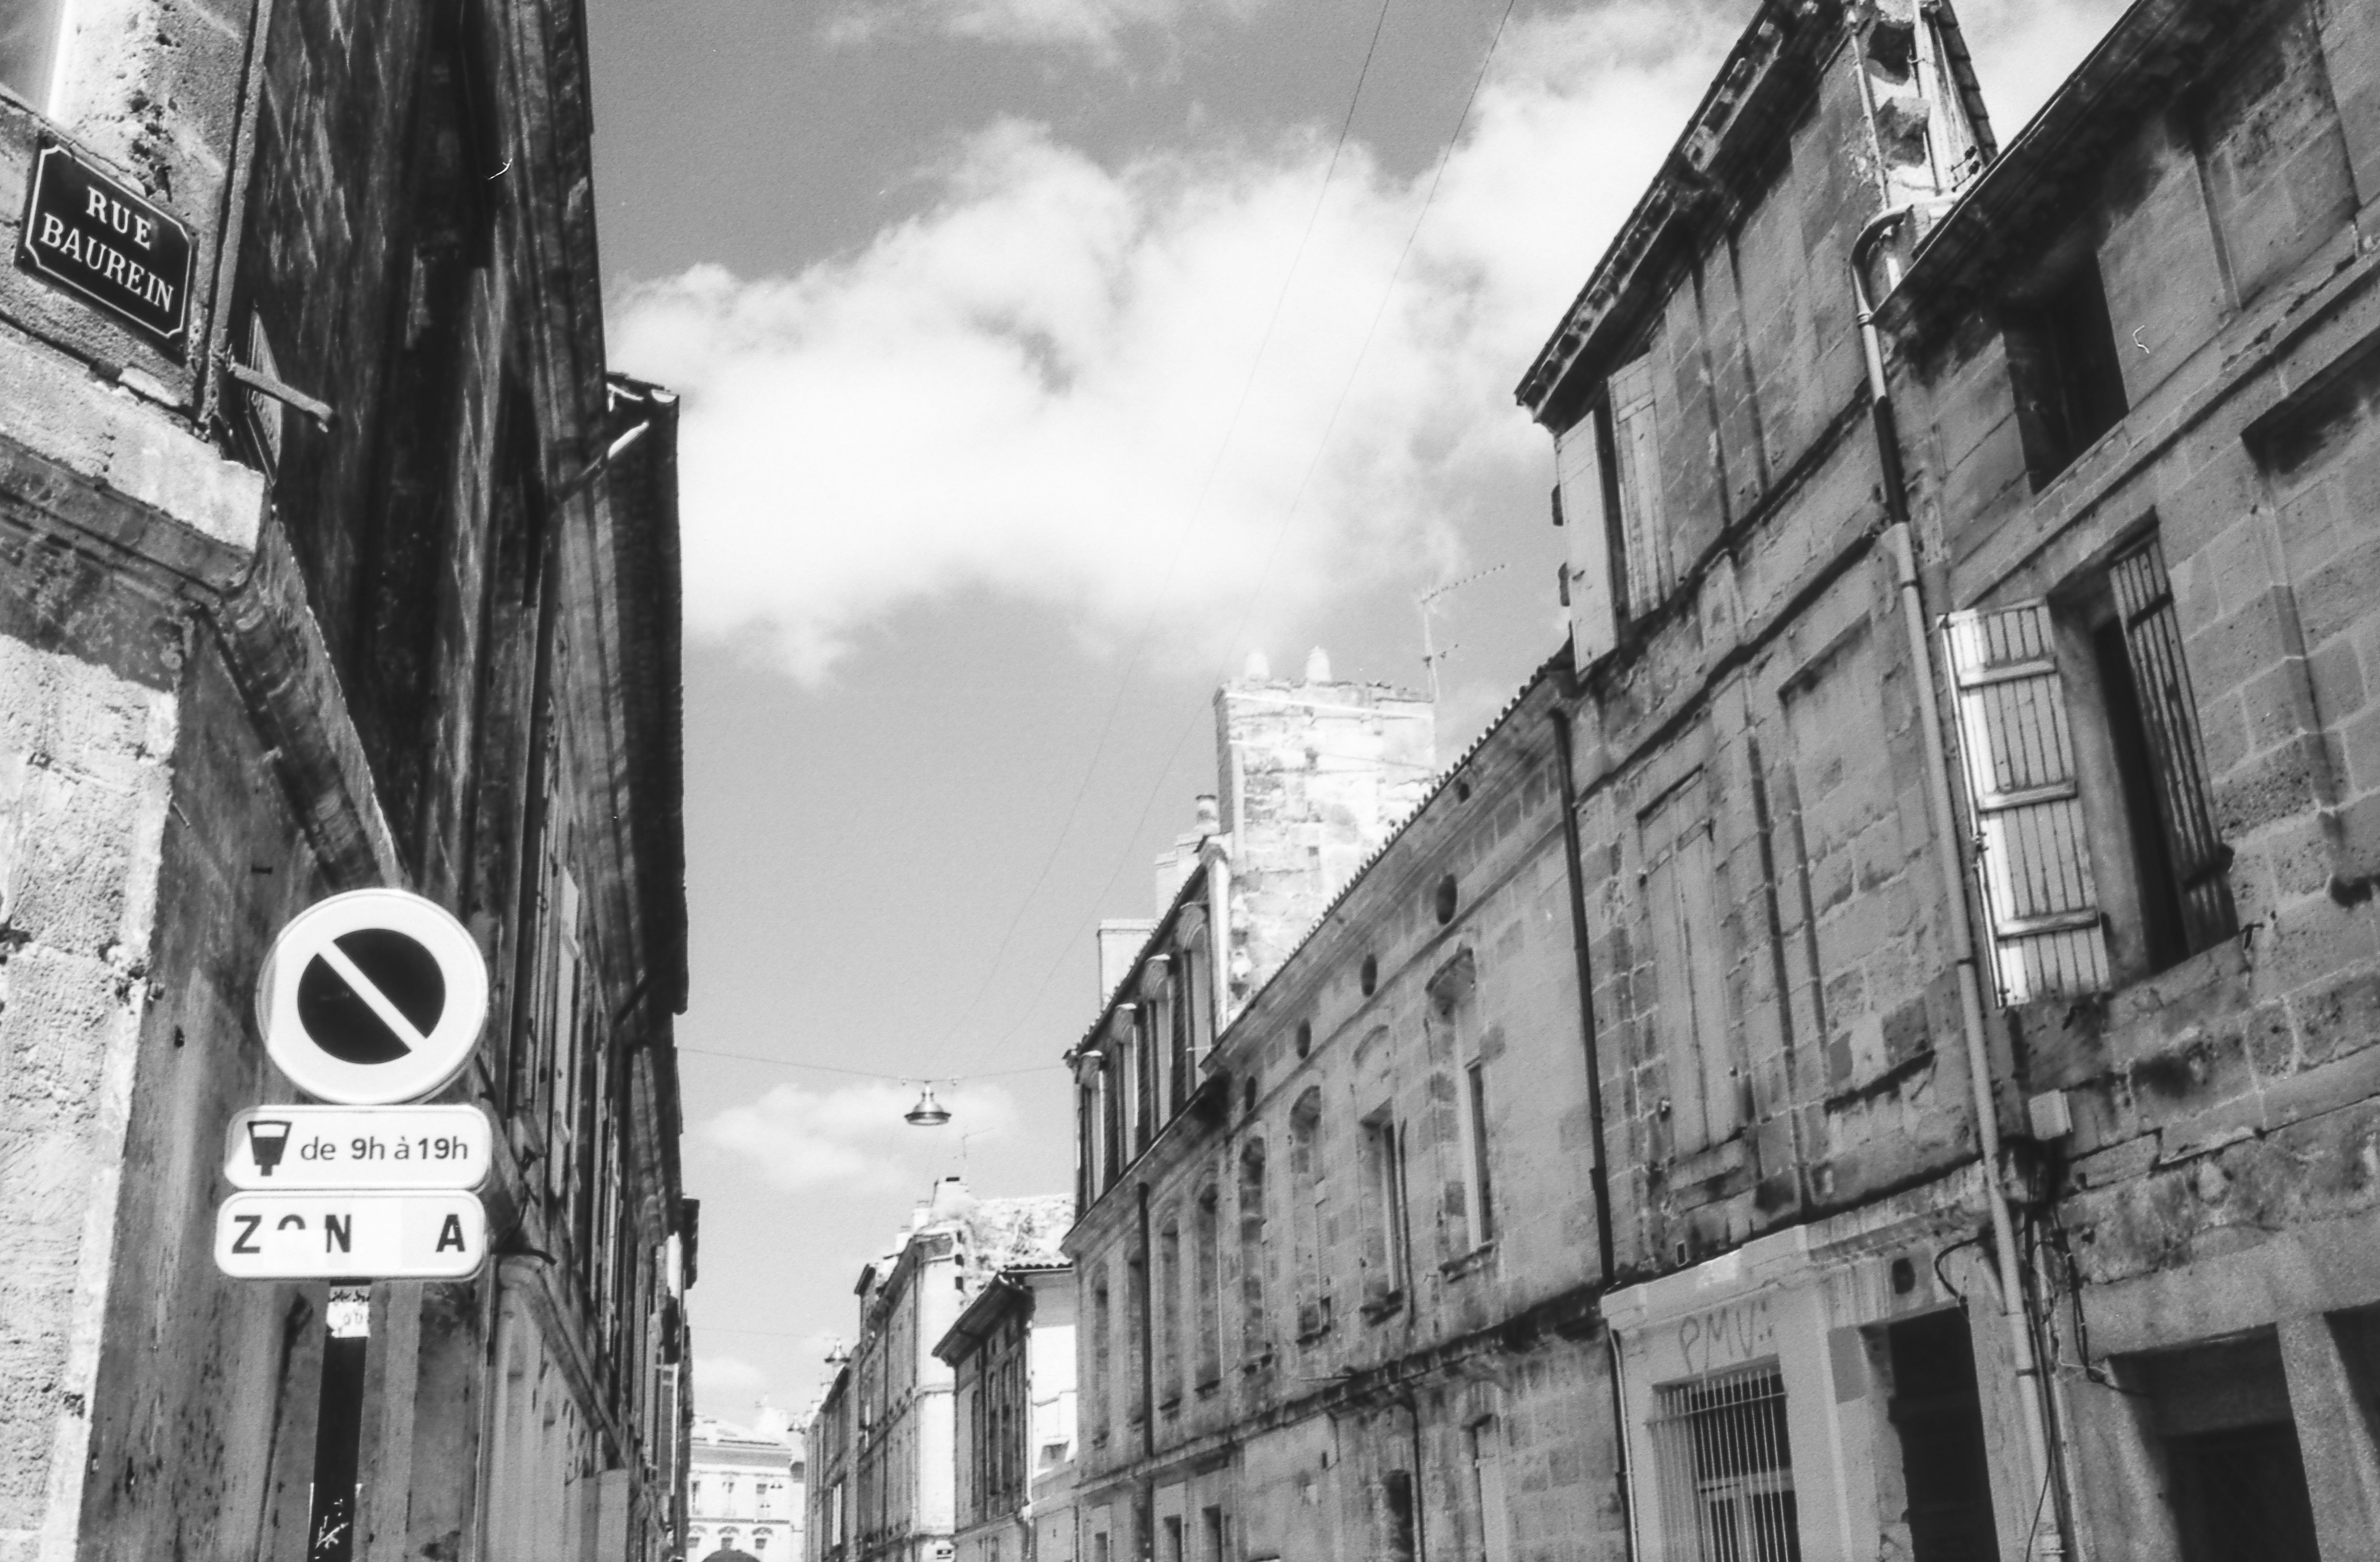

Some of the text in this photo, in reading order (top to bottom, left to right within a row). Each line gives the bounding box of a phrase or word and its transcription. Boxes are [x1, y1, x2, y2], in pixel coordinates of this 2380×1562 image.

[86, 186, 151, 250] RUE
[40, 213, 174, 312] BAUREIN
[301, 1136, 468, 1160] de 9h à 19h
[436, 1214, 466, 1252] A
